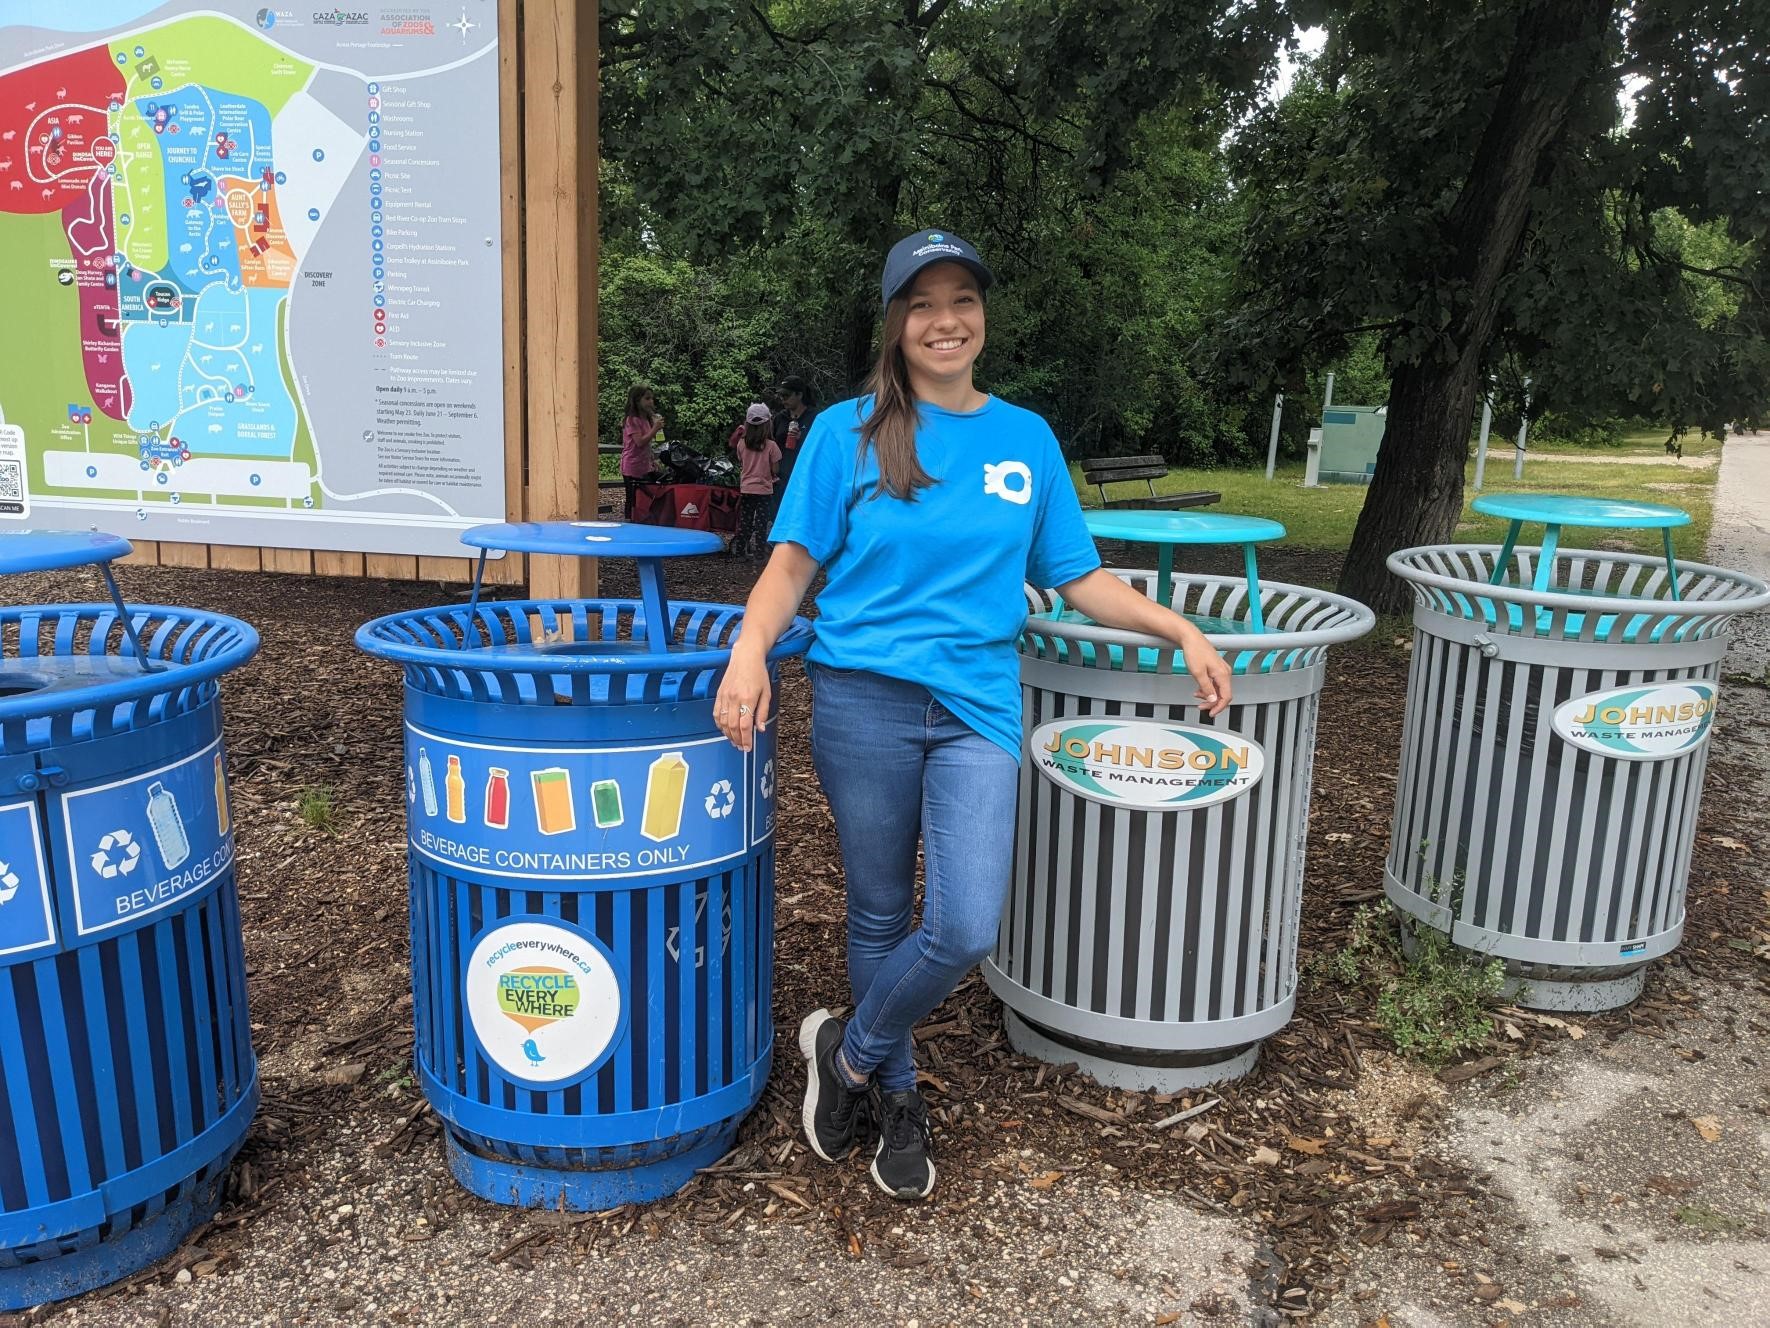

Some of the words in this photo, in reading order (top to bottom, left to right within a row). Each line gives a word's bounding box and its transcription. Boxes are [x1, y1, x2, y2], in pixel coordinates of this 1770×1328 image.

[912, 243, 950, 256] Assiniboine
[950, 244, 964, 253] Park
[918, 248, 961, 256] Conservancy
[417, 299, 440, 307] Charging
[1572, 695, 1718, 725] JOHNSON
[1570, 730, 1636, 739] WASTE
[1043, 730, 1249, 770] JOHNSON
[1042, 759, 1103, 778] WASTE
[1109, 773, 1250, 787] MANAGEMENT
[421, 830, 490, 862] BEVERAGE
[496, 850, 631, 871] CONTAINERS
[638, 844, 690, 866] ONLY
[115, 858, 211, 914] BEVERAGE
[486, 940, 592, 975] recycleeverywhere.ca
[500, 975, 576, 989] RECYCLE
[505, 989, 558, 1003] EVERY
[516, 1001, 574, 1017] WHERE
